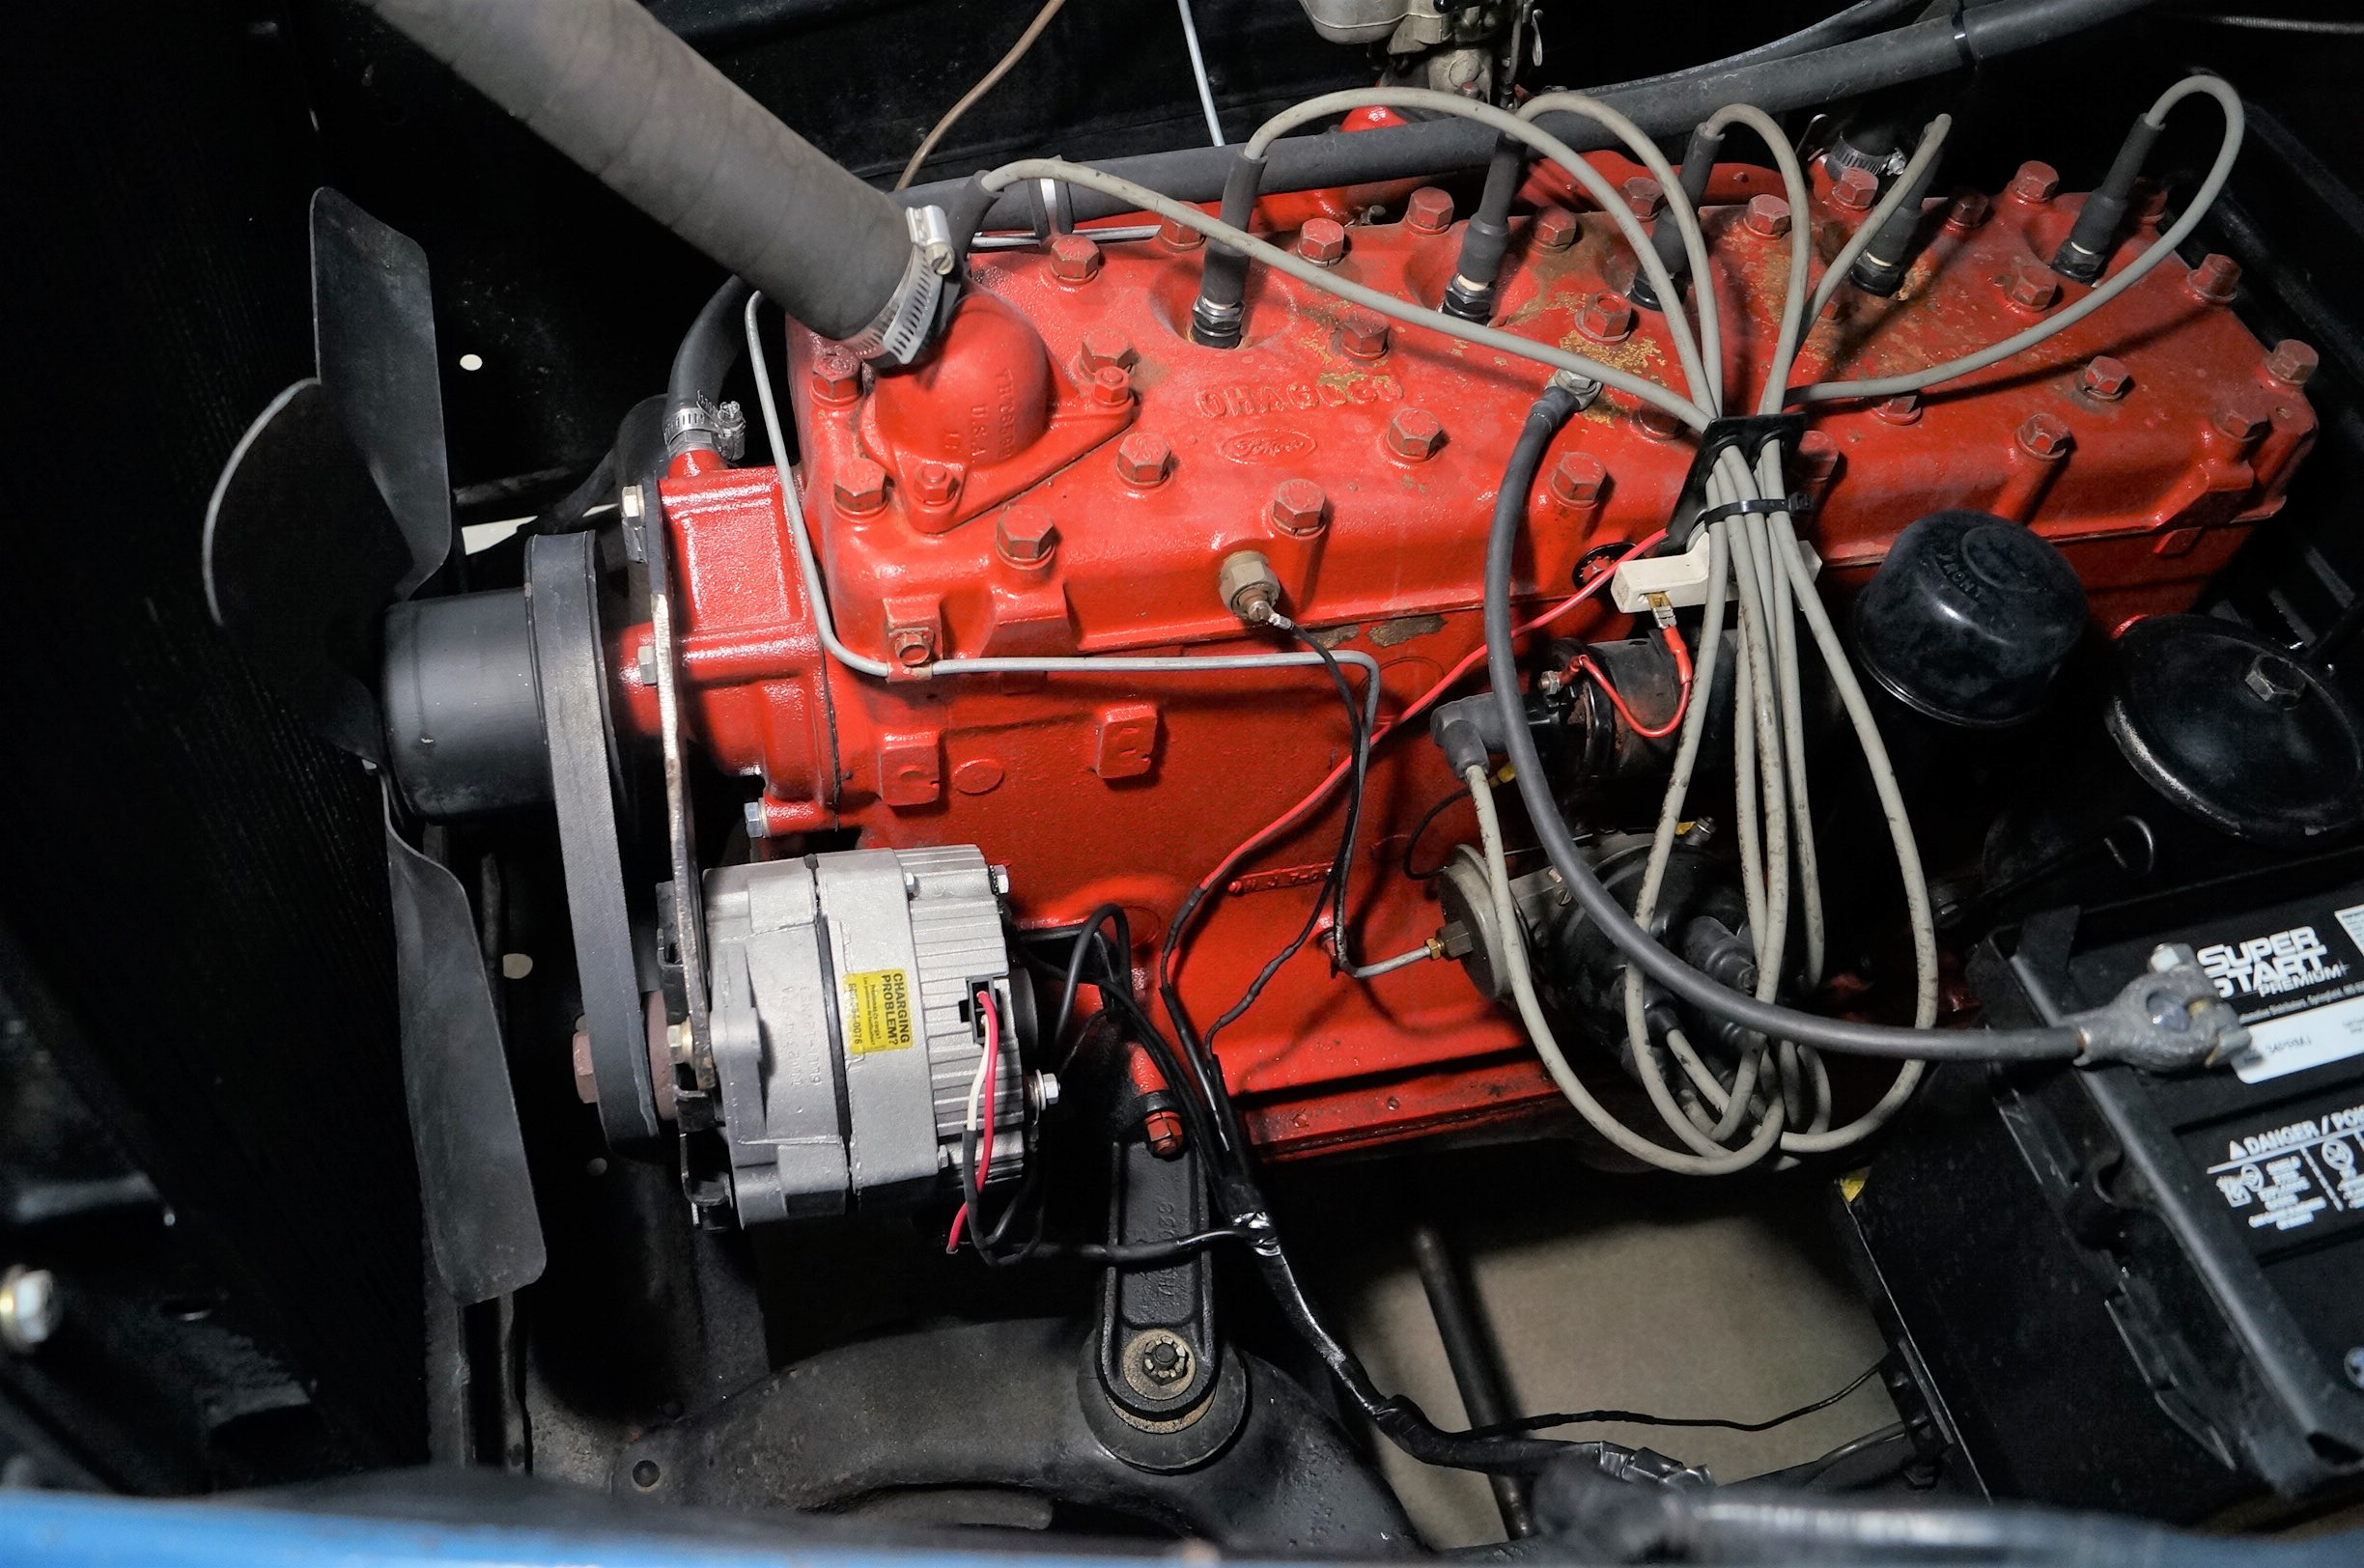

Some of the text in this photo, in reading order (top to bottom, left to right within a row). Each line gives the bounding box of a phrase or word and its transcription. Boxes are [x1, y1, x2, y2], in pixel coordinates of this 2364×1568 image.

[2197, 926, 2321, 969] SUPER
[2204, 945, 2328, 998] START
[882, 974, 899, 1047] PROBLEM?
[893, 972, 911, 1044] CHARGING
[2243, 1119, 2321, 1156] DANGER
